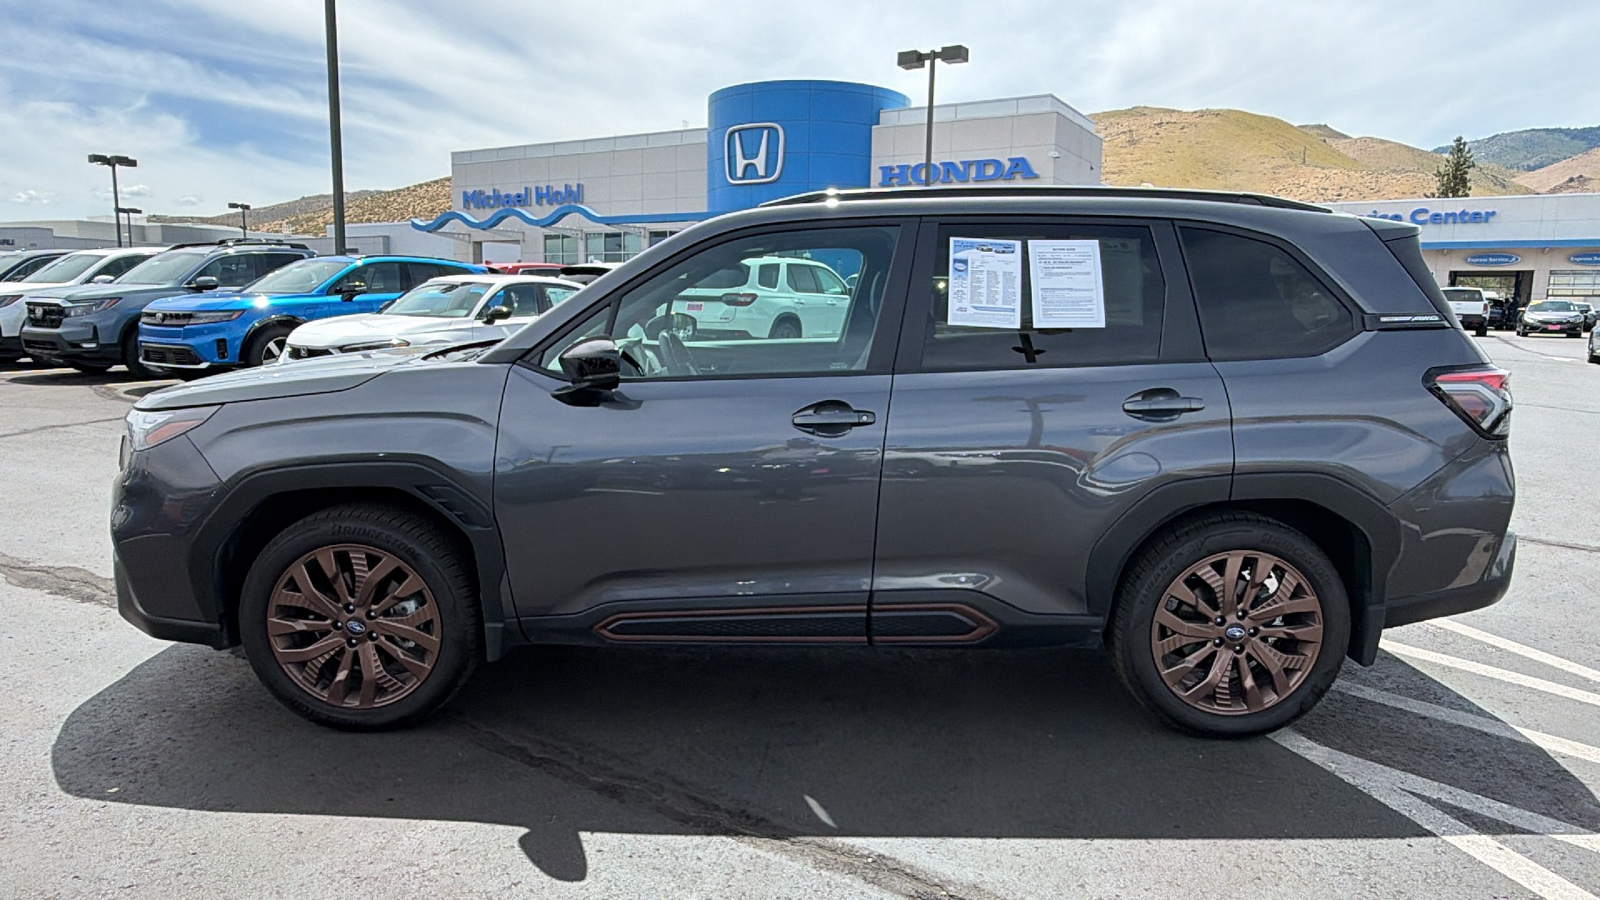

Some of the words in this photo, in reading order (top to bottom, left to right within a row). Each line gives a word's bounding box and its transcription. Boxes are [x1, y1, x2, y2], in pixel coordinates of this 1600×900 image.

[878, 156, 1040, 187] HONDA
[462, 186, 531, 210] Michael
[534, 182, 585, 206] Hohl
[1409, 207, 1497, 225] Center
